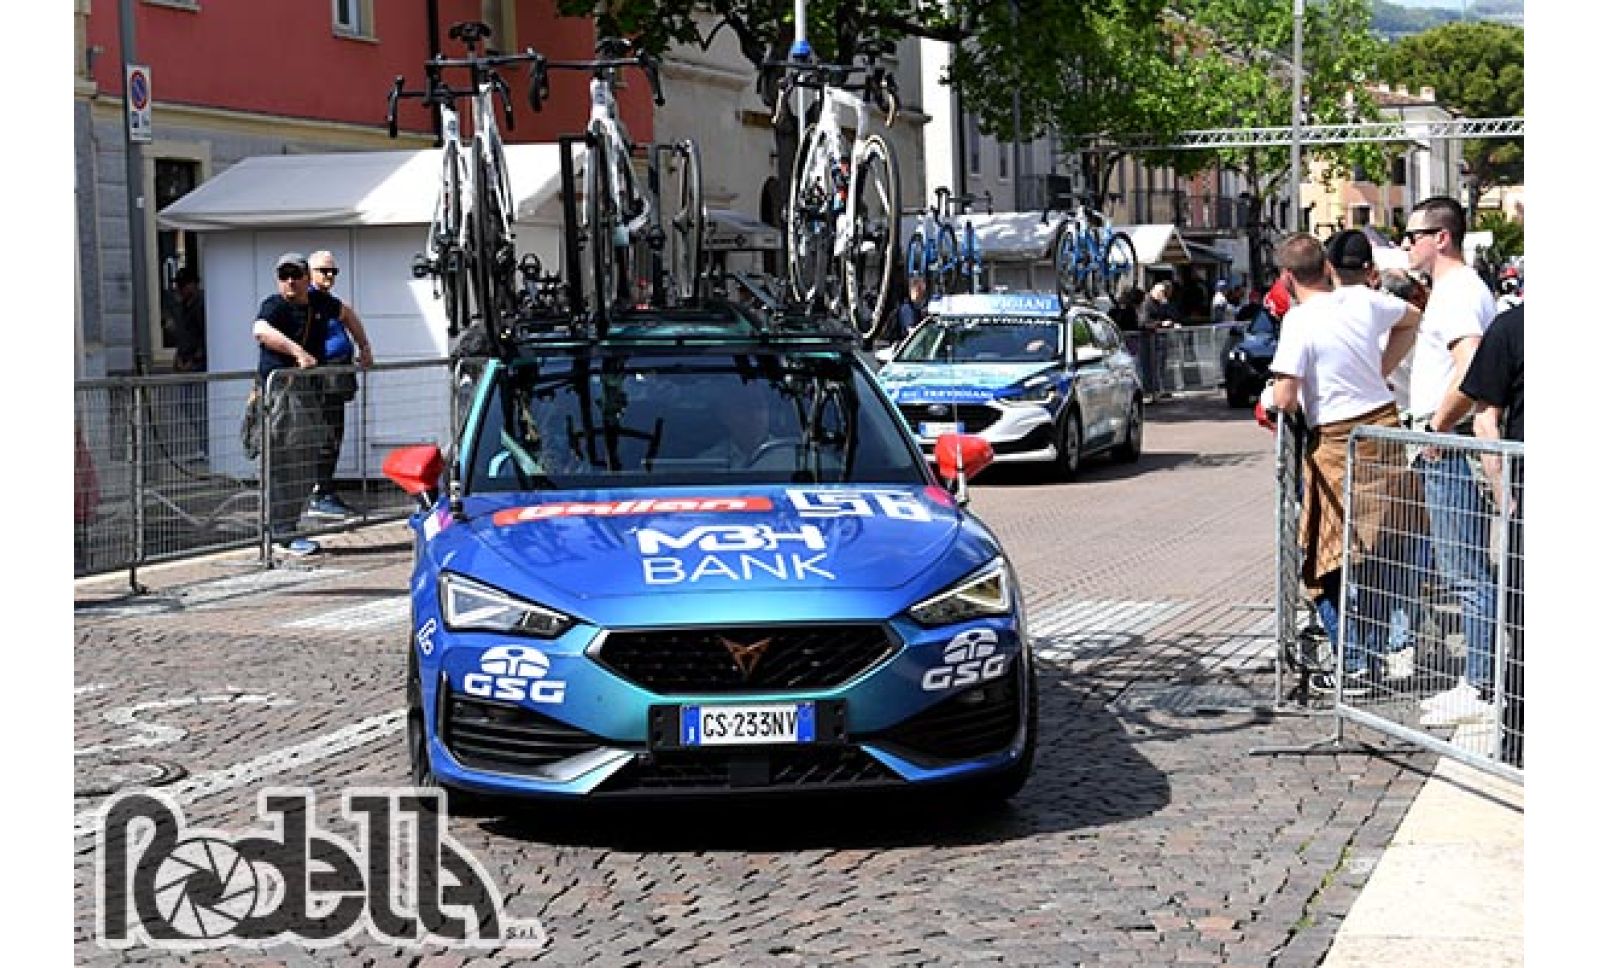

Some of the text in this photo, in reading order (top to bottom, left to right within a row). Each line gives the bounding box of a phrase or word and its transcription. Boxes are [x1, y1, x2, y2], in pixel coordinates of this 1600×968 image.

[636, 525, 826, 555] MBH
[643, 552, 836, 586] BANK
[464, 672, 567, 704] GSG
[921, 653, 1006, 691] GSG
